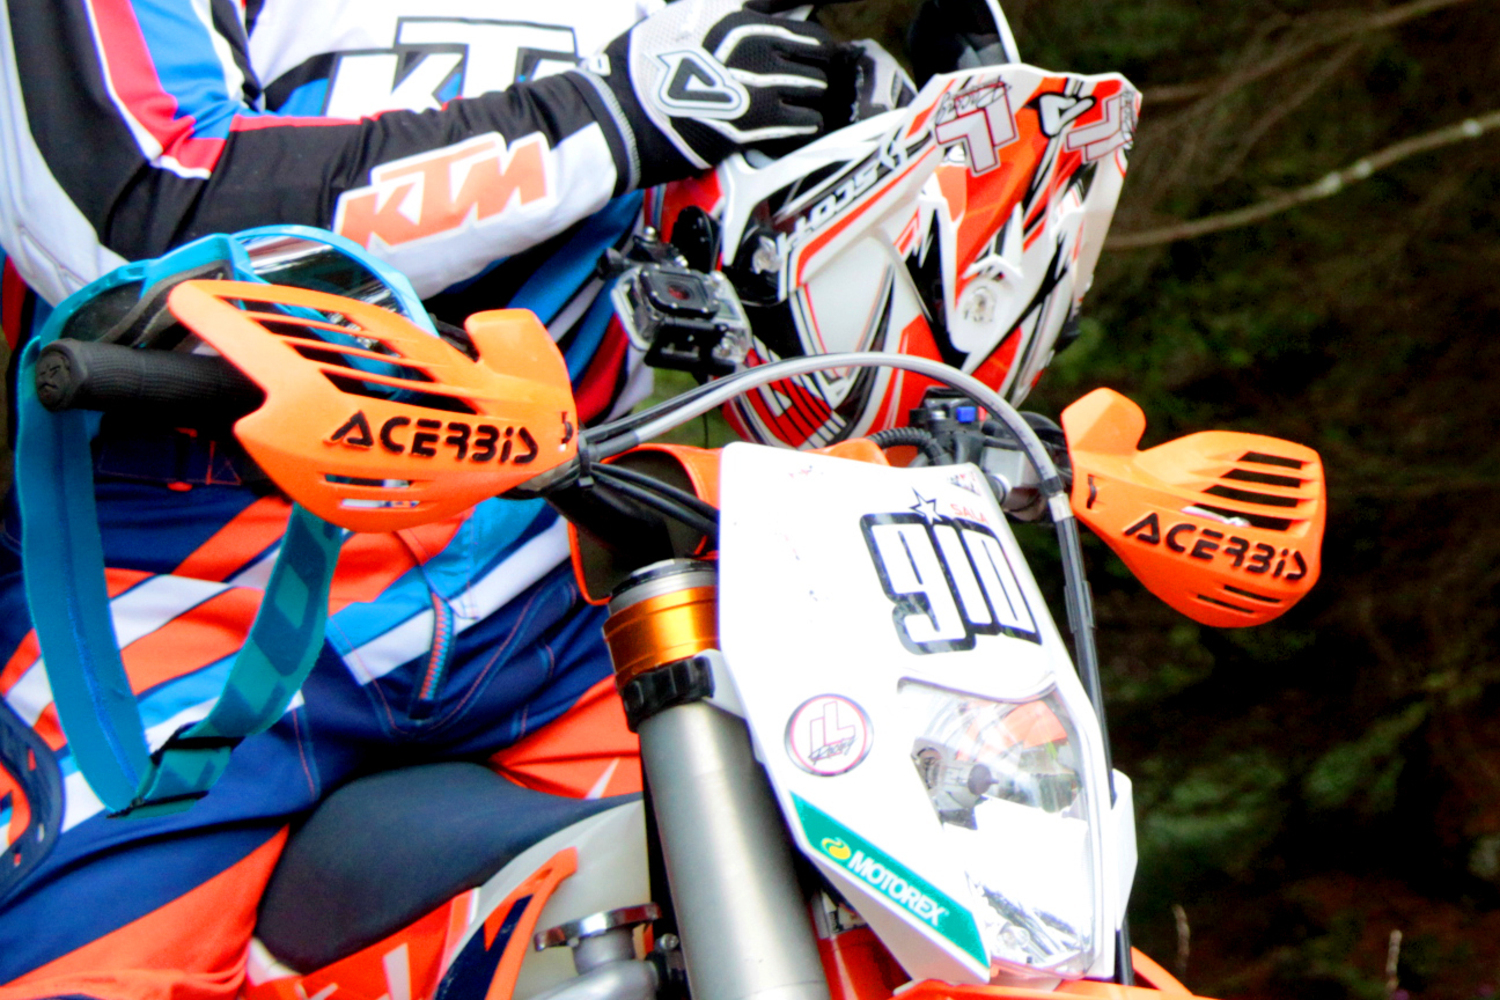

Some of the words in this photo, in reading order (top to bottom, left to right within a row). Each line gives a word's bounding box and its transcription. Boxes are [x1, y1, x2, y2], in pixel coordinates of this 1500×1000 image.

[335, 136, 552, 251] KTM
[329, 410, 539, 464] ACERBIS
[1124, 513, 1308, 582] ACERBIS
[848, 849, 946, 926] MOTOREX
